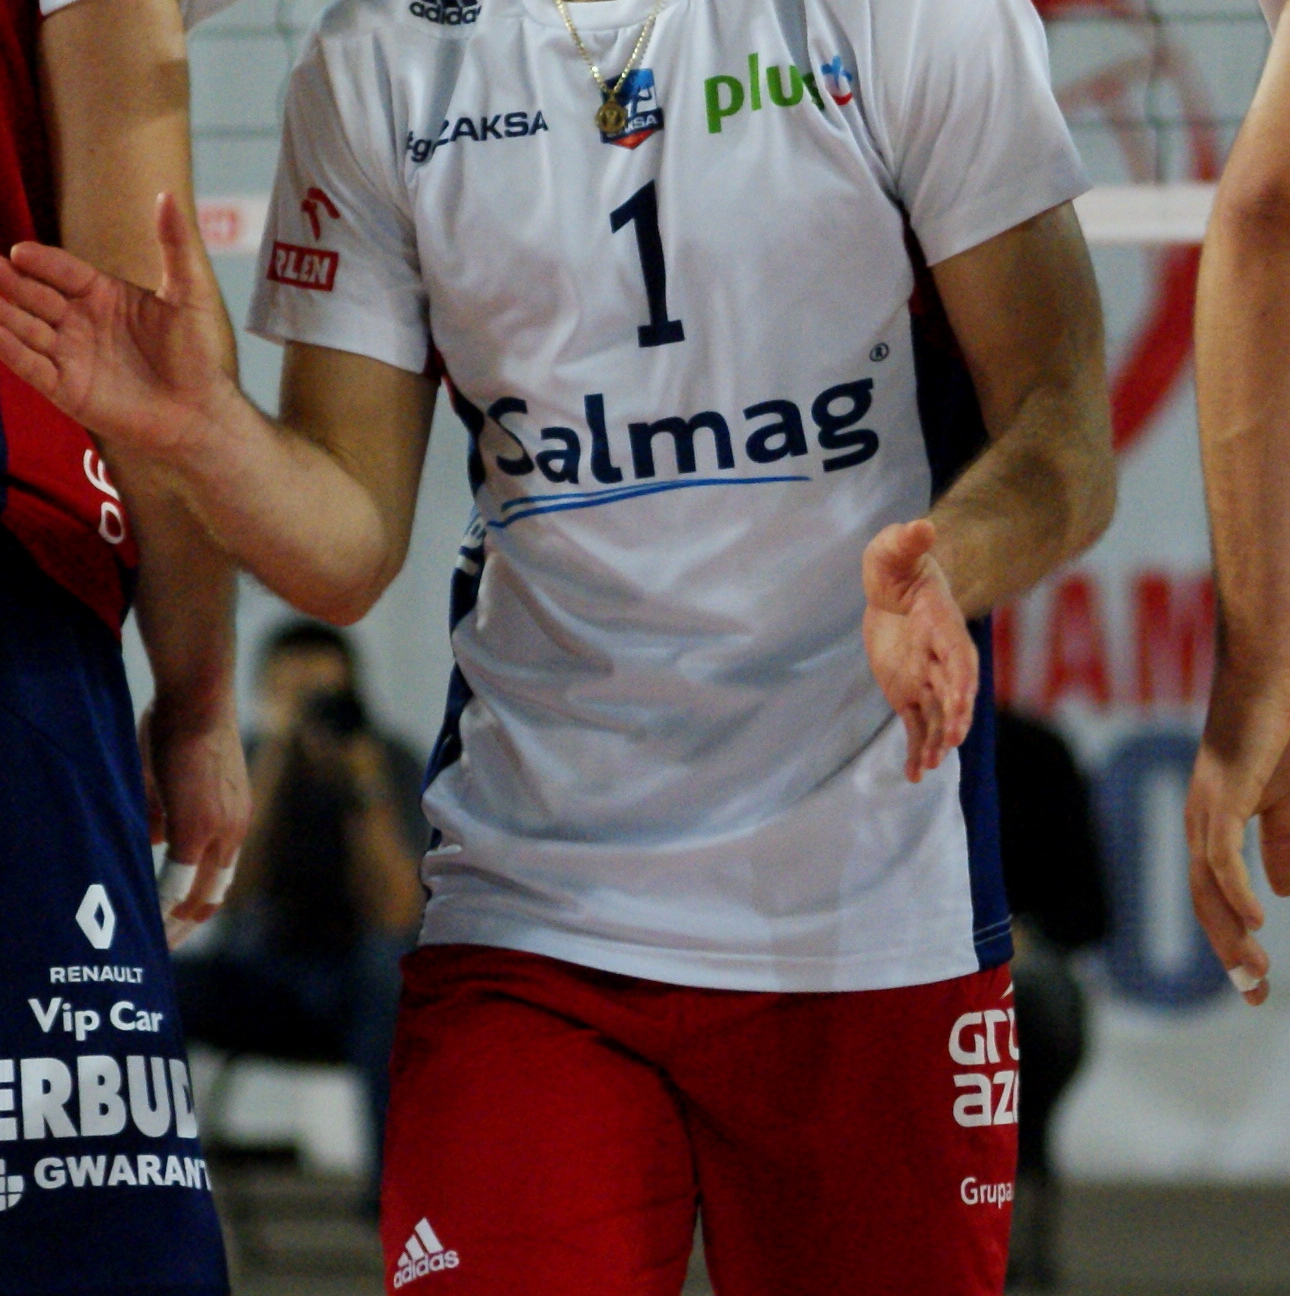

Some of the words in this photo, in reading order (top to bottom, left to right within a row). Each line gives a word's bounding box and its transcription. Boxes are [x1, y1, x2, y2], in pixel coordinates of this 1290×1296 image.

[409, 1, 482, 26] adida
[275, 249, 331, 284] RLEN
[609, 179, 686, 348] 1
[487, 378, 880, 486] Salmag
[49, 965, 145, 985] RENAULT
[28, 996, 100, 1041] Vip
[109, 1001, 164, 1033] Car
[34, 1154, 213, 1191] GWARANT
[960, 1176, 1014, 1209] Grupa
[393, 1250, 460, 1289] adidas
